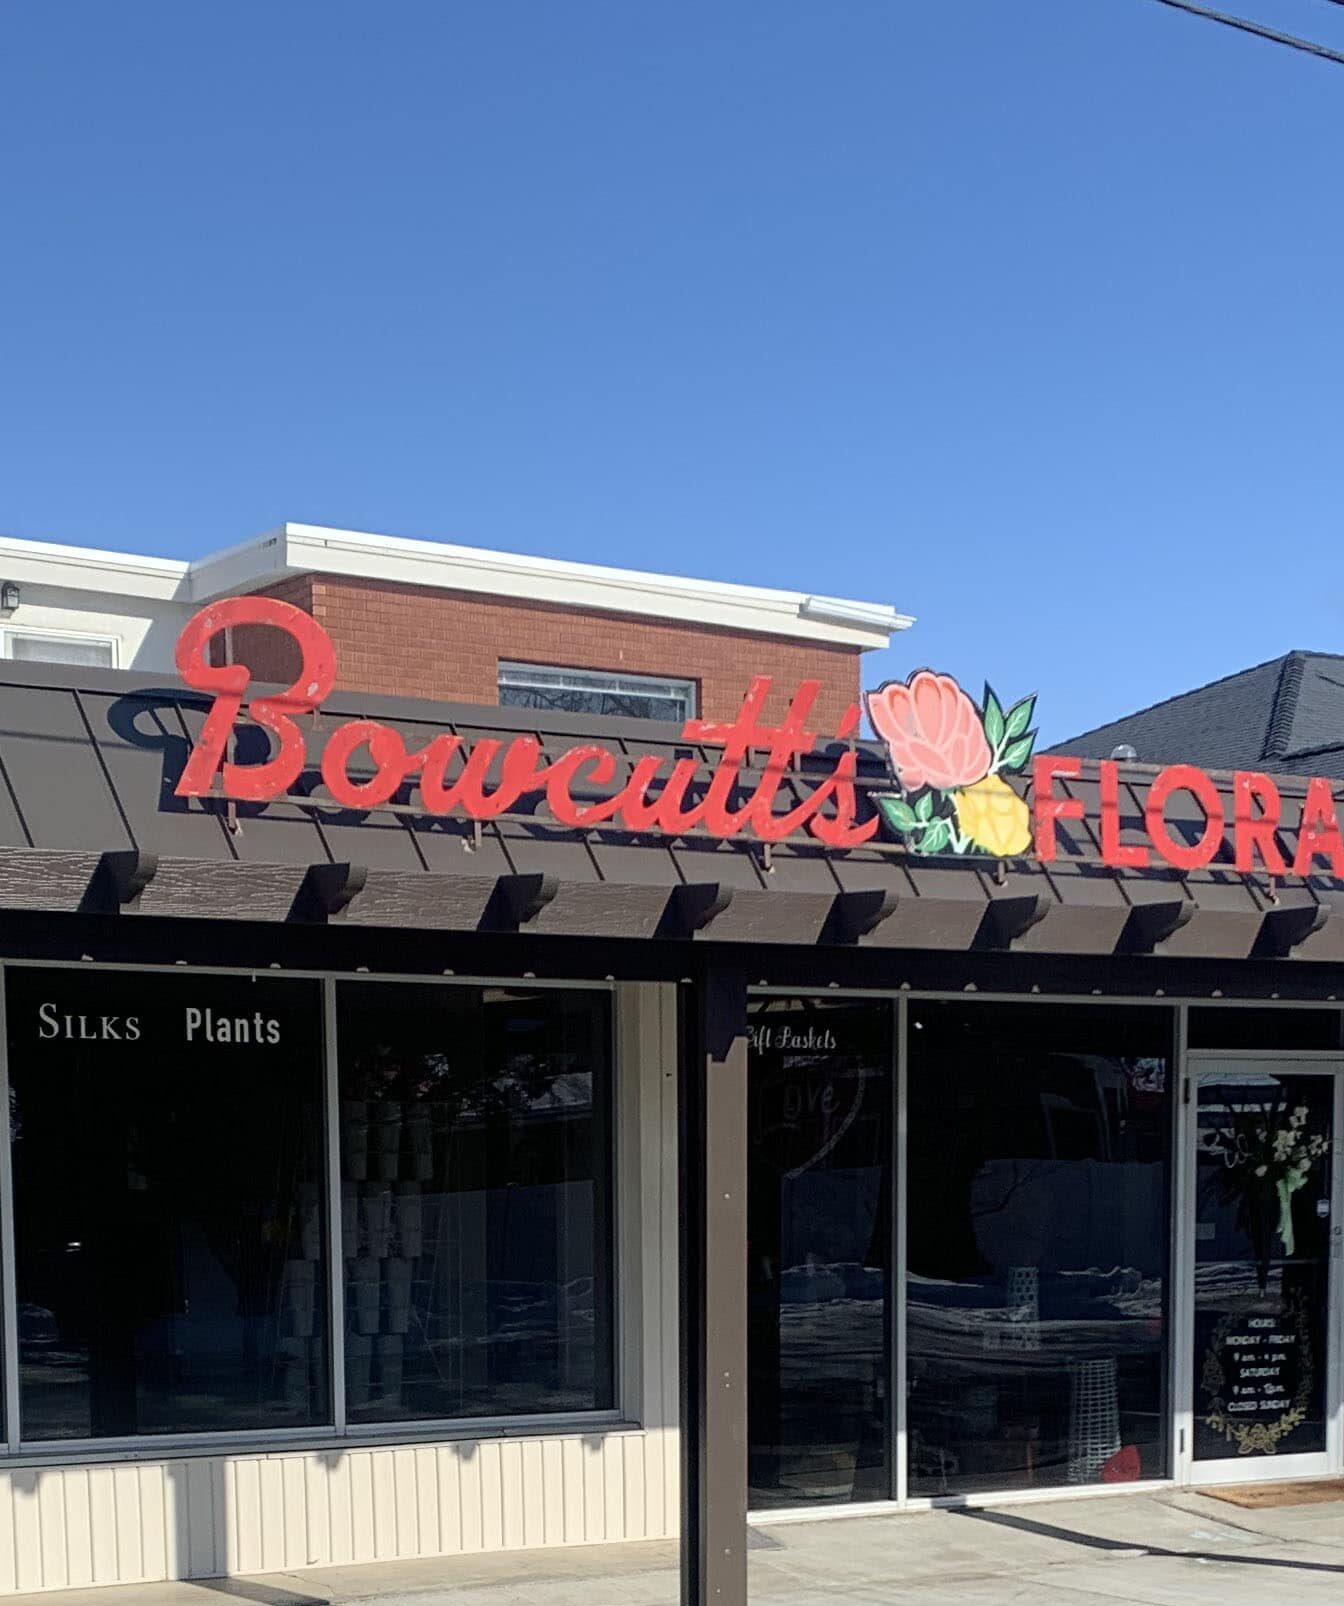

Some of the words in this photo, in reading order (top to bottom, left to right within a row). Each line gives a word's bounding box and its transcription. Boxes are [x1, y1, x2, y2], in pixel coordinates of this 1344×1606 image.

[175, 597, 880, 847] Bowcutt's
[186, 1007, 281, 1044] Plants
[775, 1025, 837, 1050] Baskets
